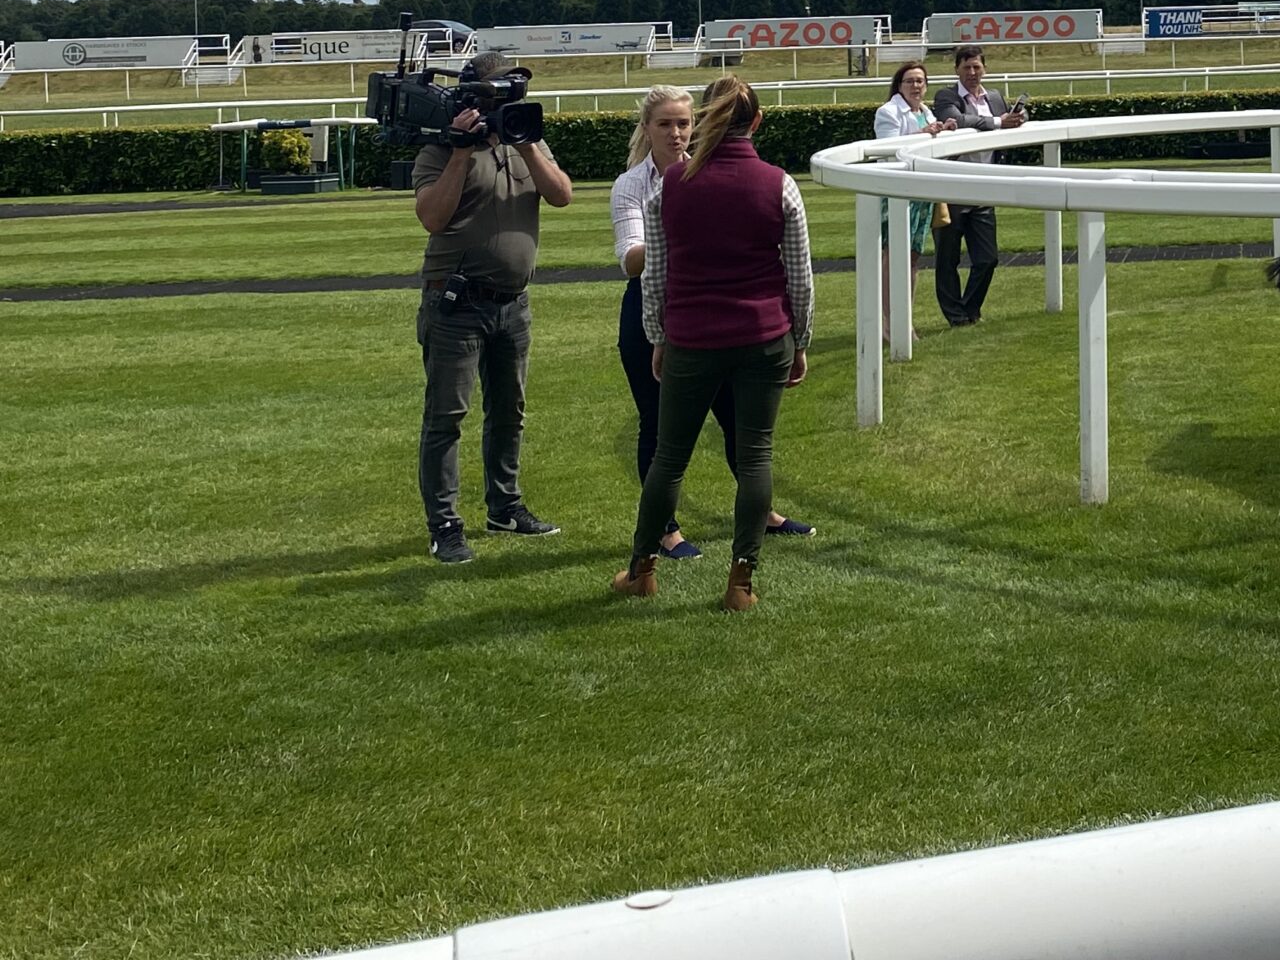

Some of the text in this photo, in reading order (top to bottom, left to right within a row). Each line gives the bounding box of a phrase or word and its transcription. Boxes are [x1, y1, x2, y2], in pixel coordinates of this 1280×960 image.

[727, 21, 853, 47] CAZOO
[953, 15, 1076, 41] CAZOO
[1160, 24, 1181, 35] YOU
[301, 36, 350, 61] ique
